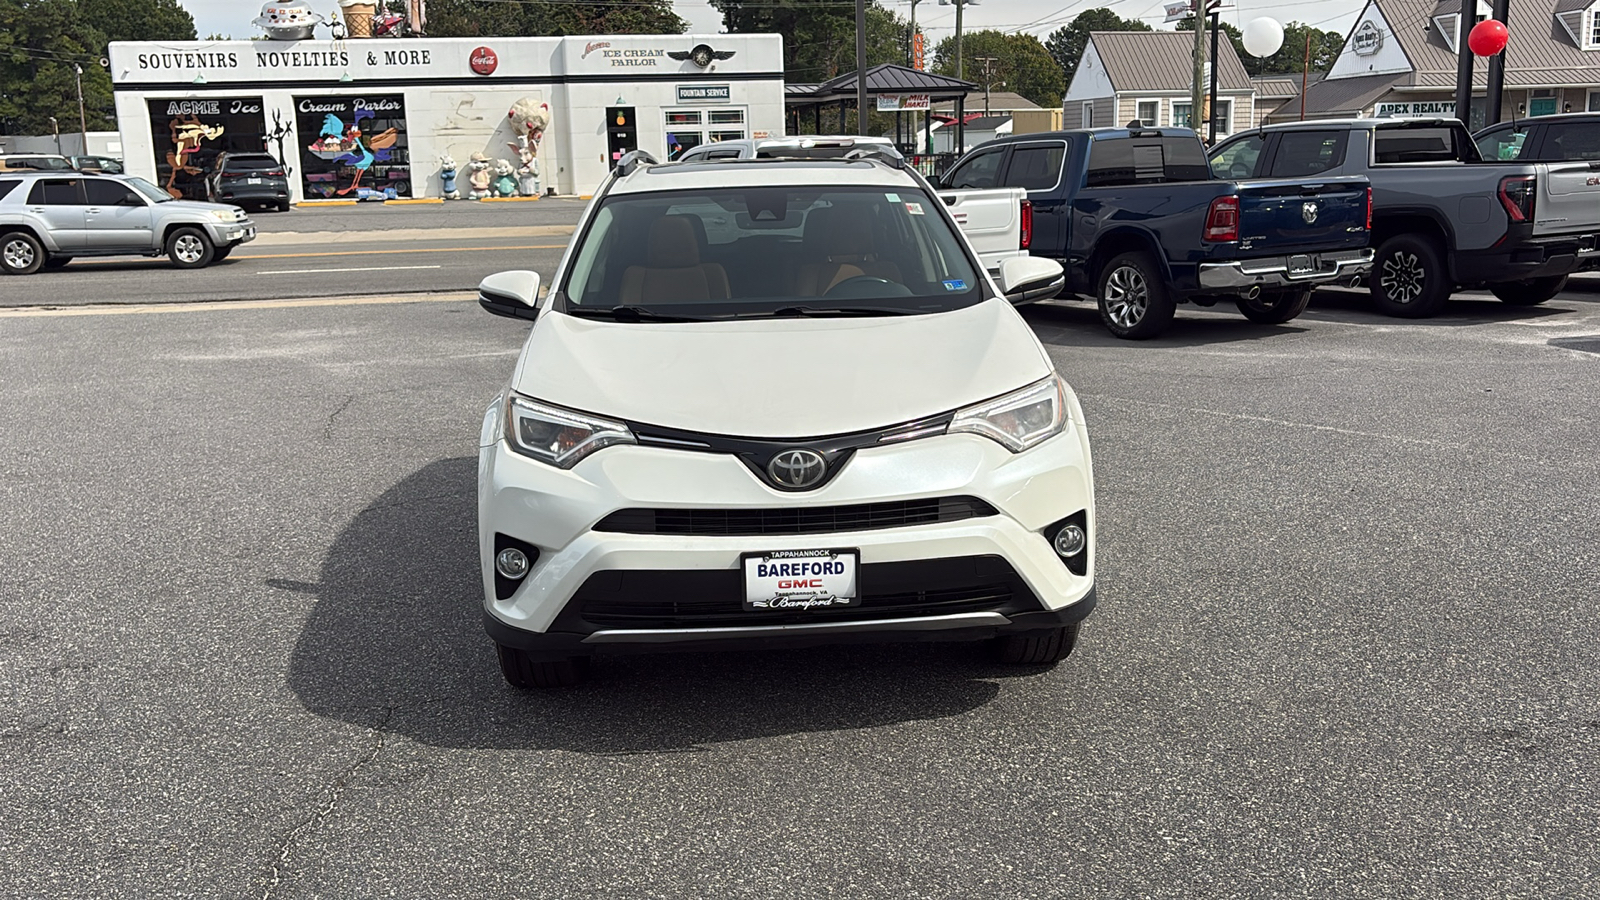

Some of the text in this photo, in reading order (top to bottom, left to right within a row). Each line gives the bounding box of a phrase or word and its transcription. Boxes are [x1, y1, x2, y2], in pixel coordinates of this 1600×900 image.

[603, 49, 665, 58] ICE CREAM
[138, 50, 431, 69] SOUVENIRS NOVELTIES & MORE
[611, 58, 657, 67] PARLOR
[680, 87, 729, 98] FOUNTAIN SERVICE
[167, 100, 260, 115] ACME Ice
[299, 98, 402, 113] Cream Parlor
[1379, 102, 1457, 113] APEX REALTY
[771, 549, 830, 558] TAPPAHANNOCK
[757, 562, 845, 577] BAREFORD
[778, 579, 823, 588] GMC
[769, 595, 835, 610] Bareford
